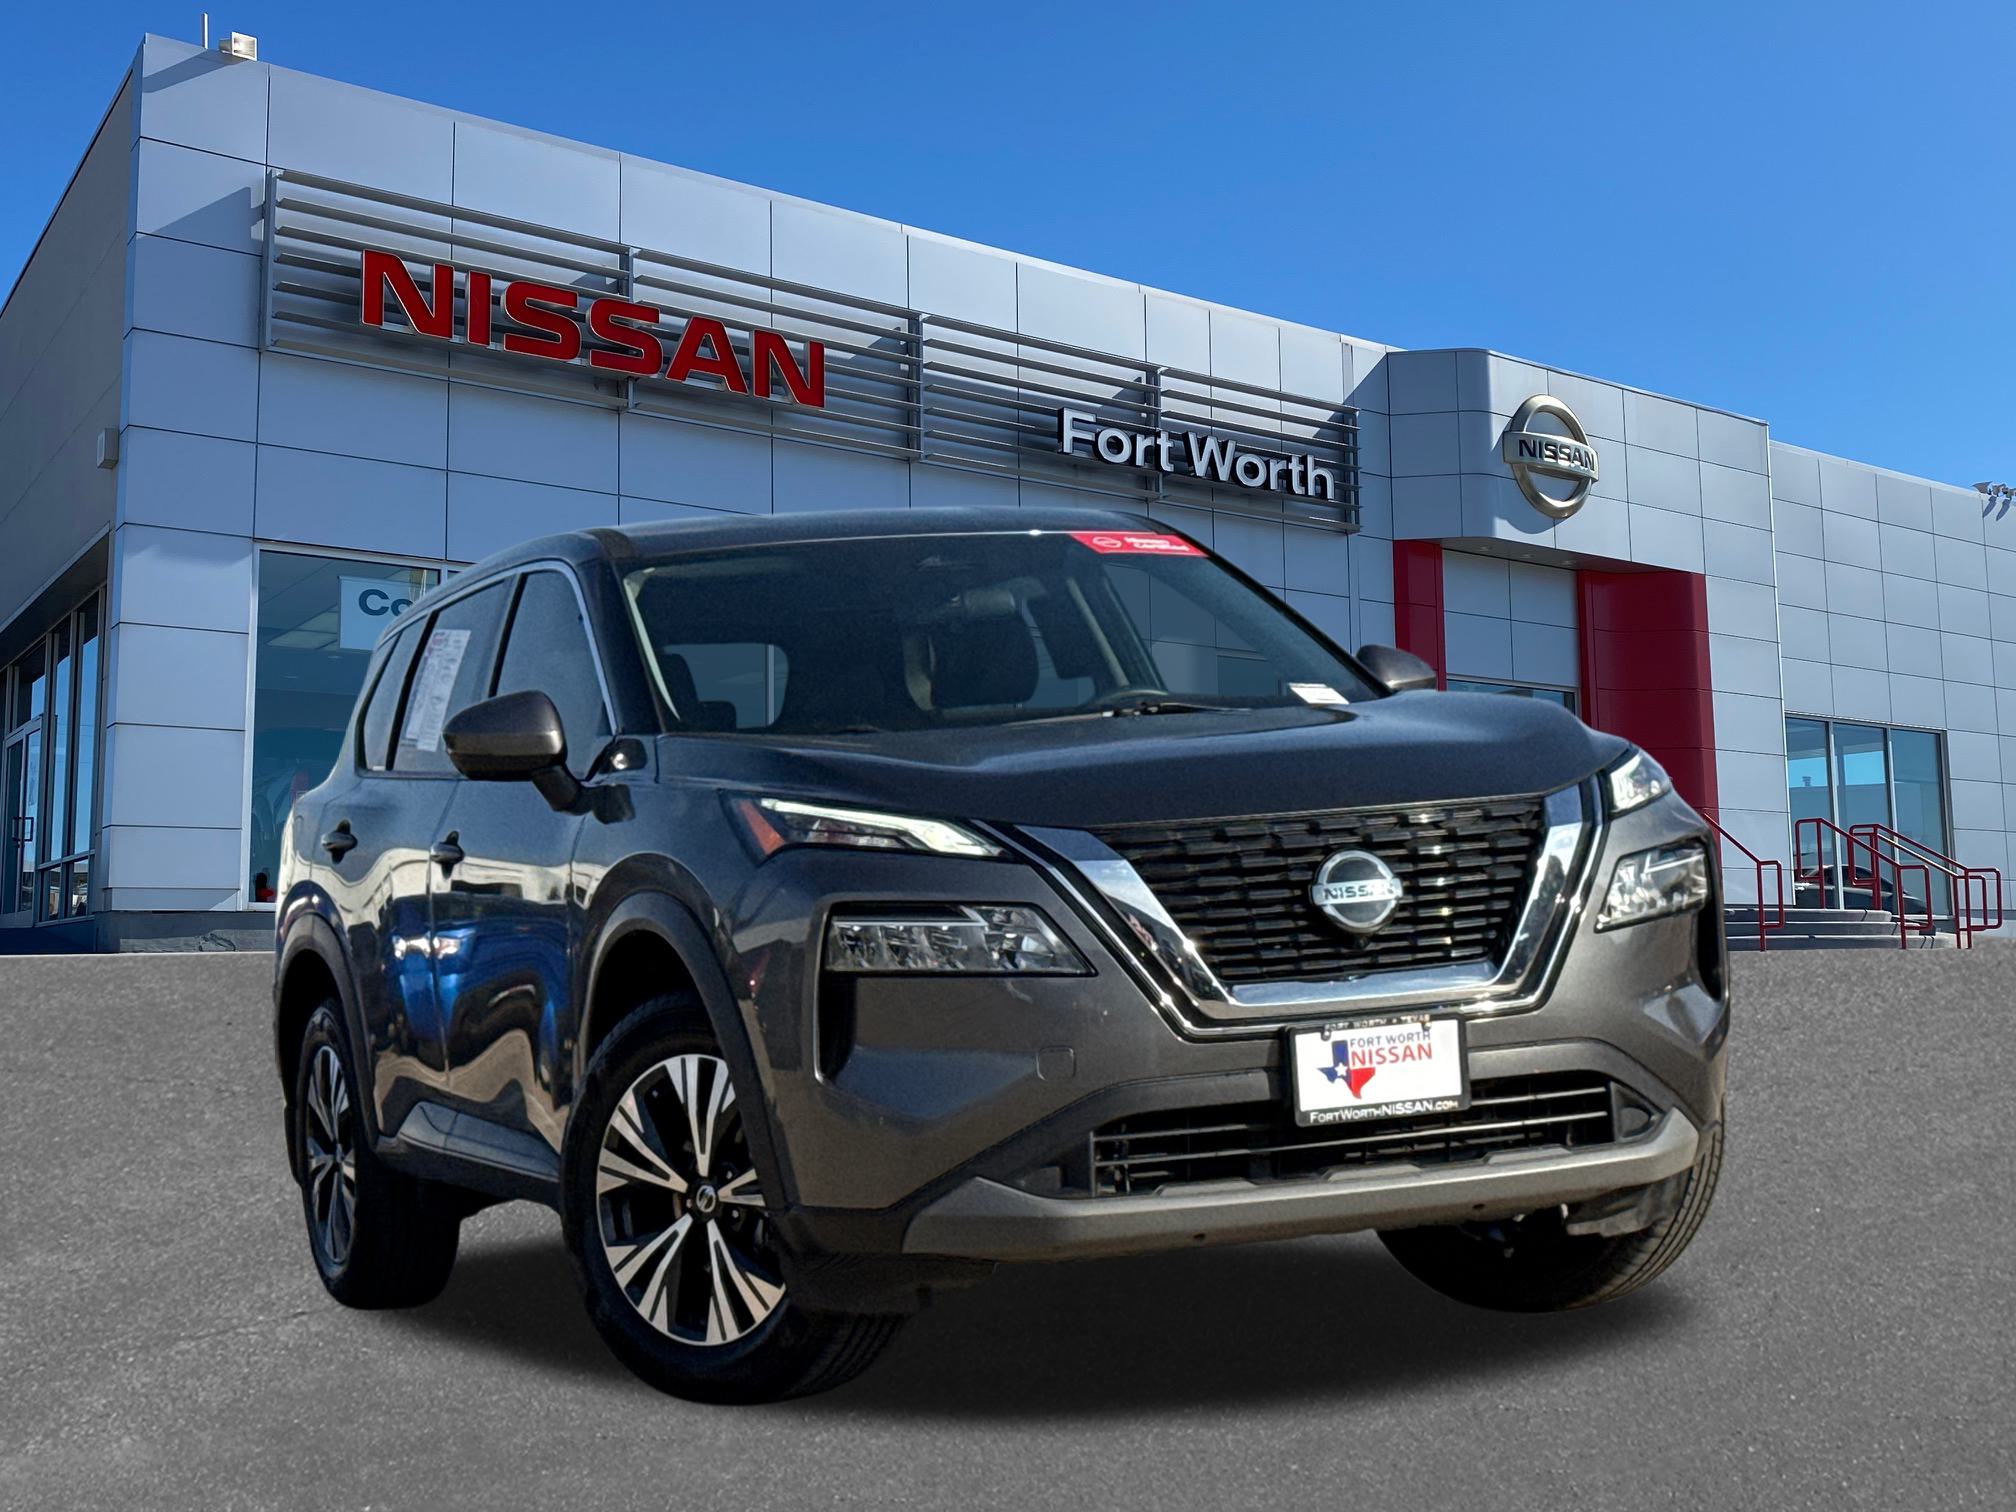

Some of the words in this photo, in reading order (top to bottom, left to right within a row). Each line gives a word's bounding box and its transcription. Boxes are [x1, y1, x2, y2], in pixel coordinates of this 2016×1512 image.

[361, 248, 825, 408] NISSAN
[1058, 407, 1175, 472] Fort
[1183, 431, 1335, 500] Worth
[1518, 439, 1595, 472] NISSAN
[1323, 882, 1395, 900] NISS
[1324, 1021, 1349, 1031] FORT
[1353, 1018, 1387, 1028] WORTH
[1350, 1036, 1381, 1049] FORT
[1386, 1031, 1431, 1045] WORTH
[1351, 1043, 1433, 1067] NISSAN
